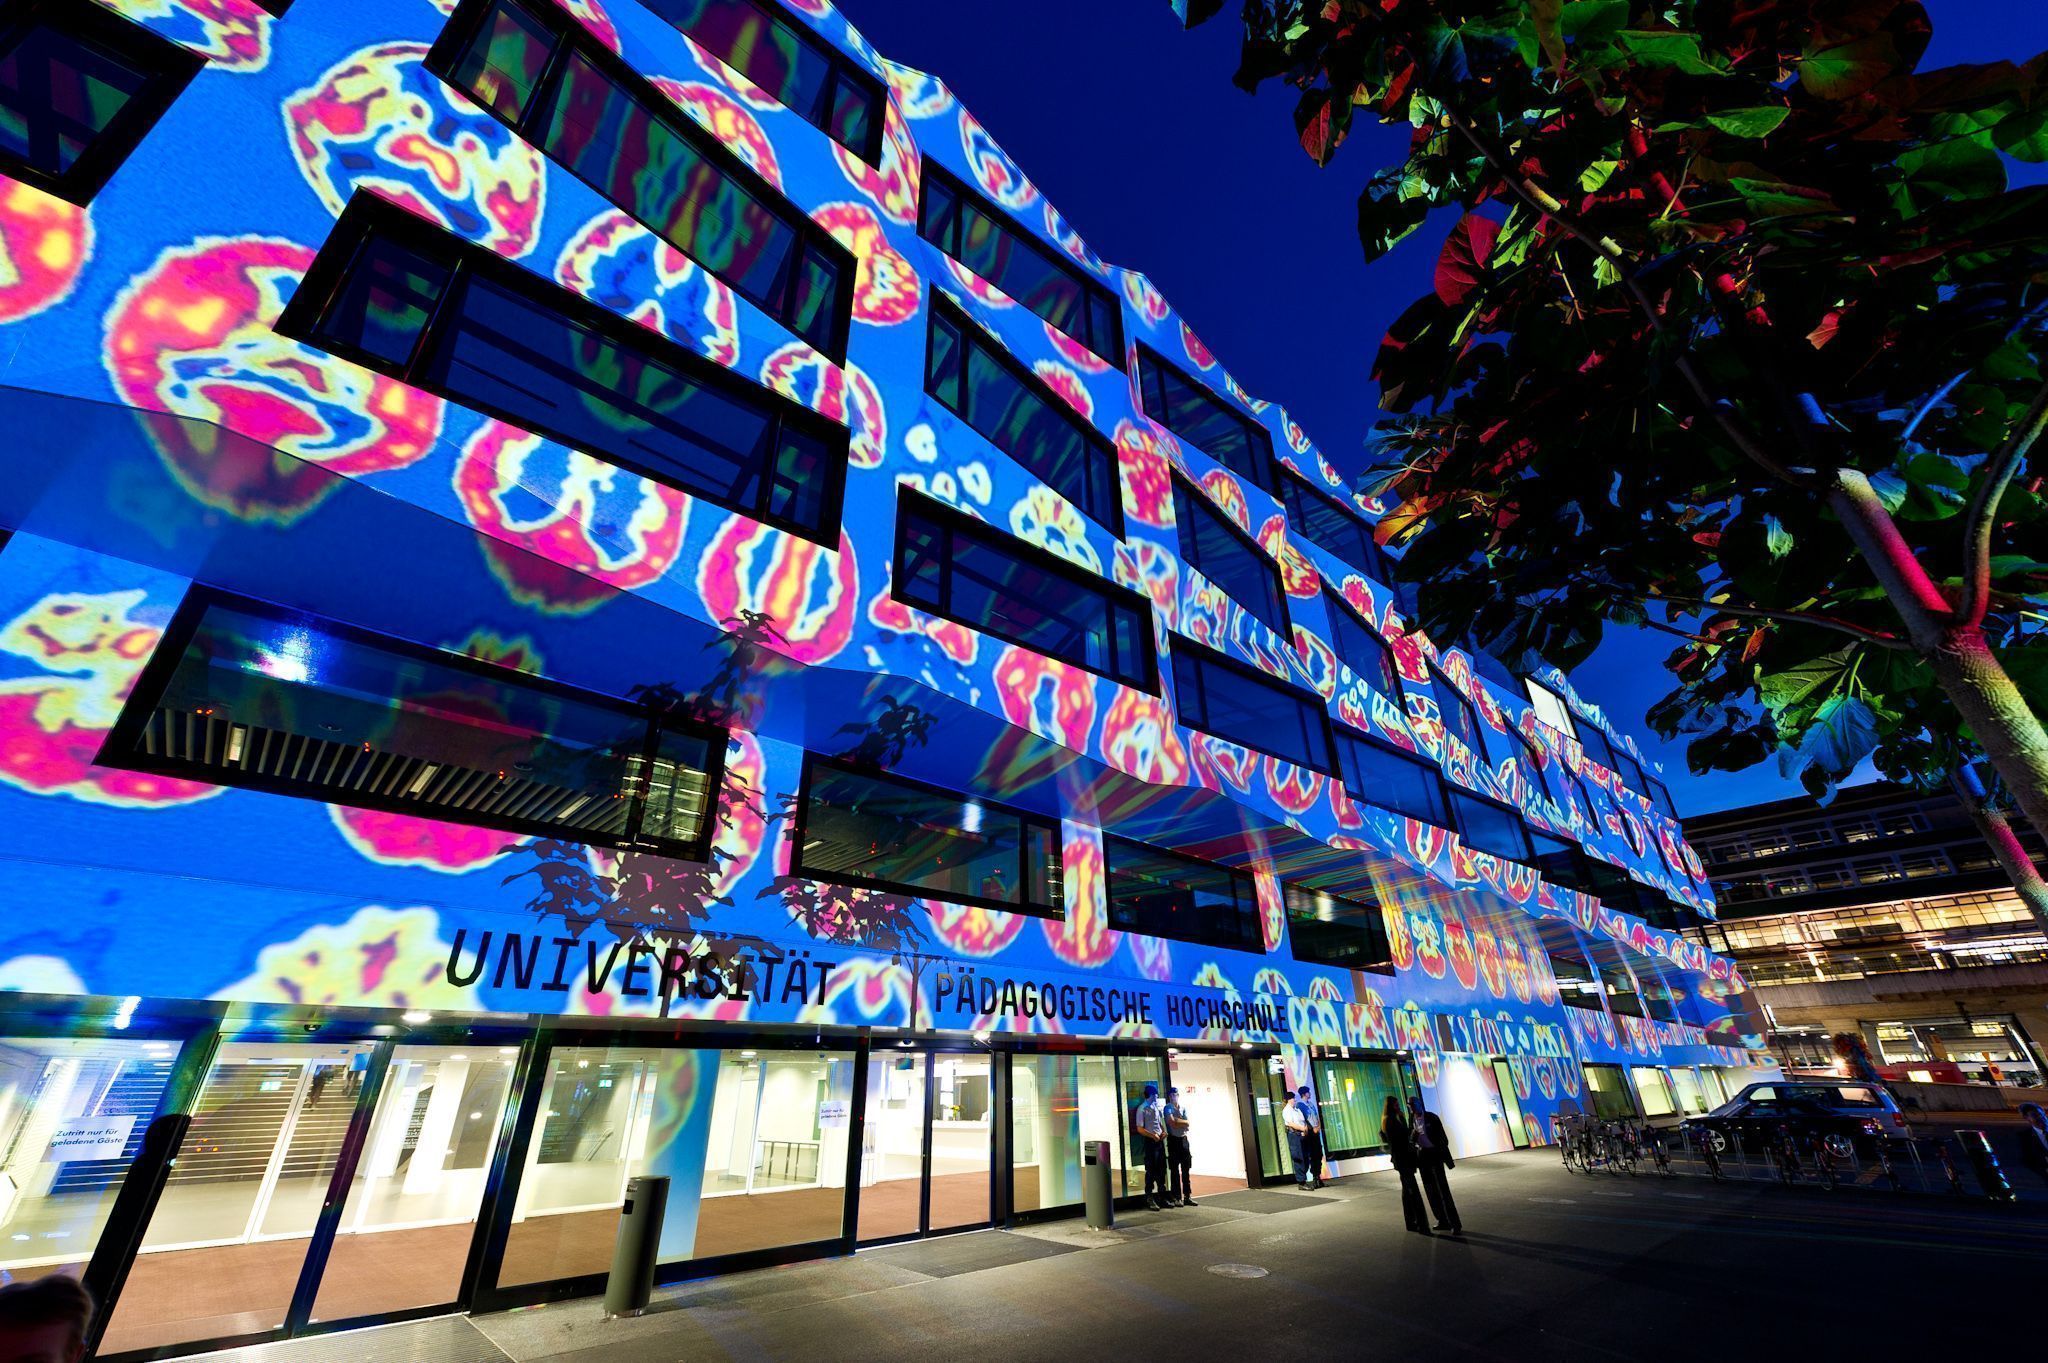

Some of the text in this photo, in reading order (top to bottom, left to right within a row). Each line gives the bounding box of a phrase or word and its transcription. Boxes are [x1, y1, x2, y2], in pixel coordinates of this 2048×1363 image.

[445, 928, 1290, 1033] UNIVERSITÄT PÄDAGOGISCHE HOCHSCHULE
[56, 1129, 85, 1137] Zutritt
[51, 1138, 95, 1147] geladene
